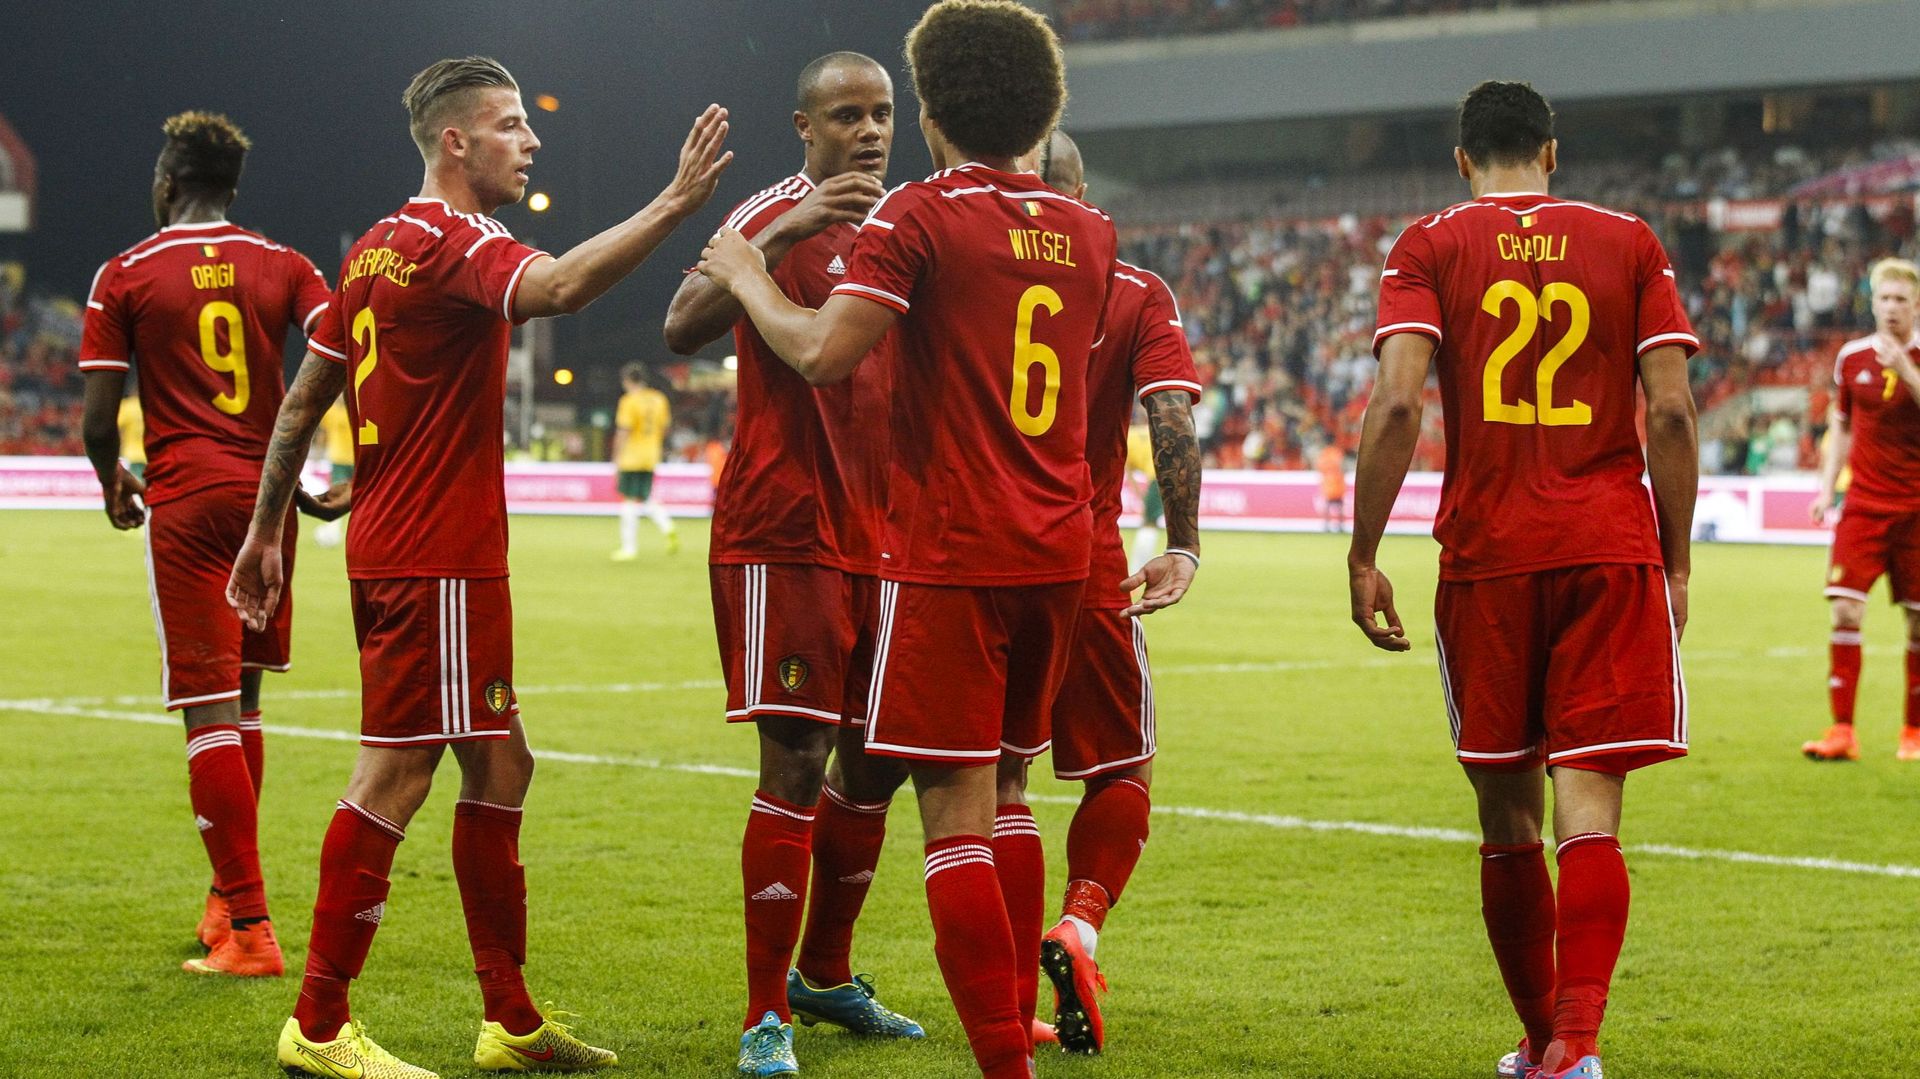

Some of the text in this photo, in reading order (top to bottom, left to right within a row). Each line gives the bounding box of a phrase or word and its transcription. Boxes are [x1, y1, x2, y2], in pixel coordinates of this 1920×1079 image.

[191, 262, 235, 290] ORIGI
[1008, 228, 1077, 268] WITSEL
[1496, 233, 1567, 263] CHADLI
[198, 301, 250, 415] 9
[351, 306, 379, 446] 2
[1010, 284, 1064, 437] 6
[1481, 279, 1592, 427] 22
[751, 892, 799, 901] adidas
